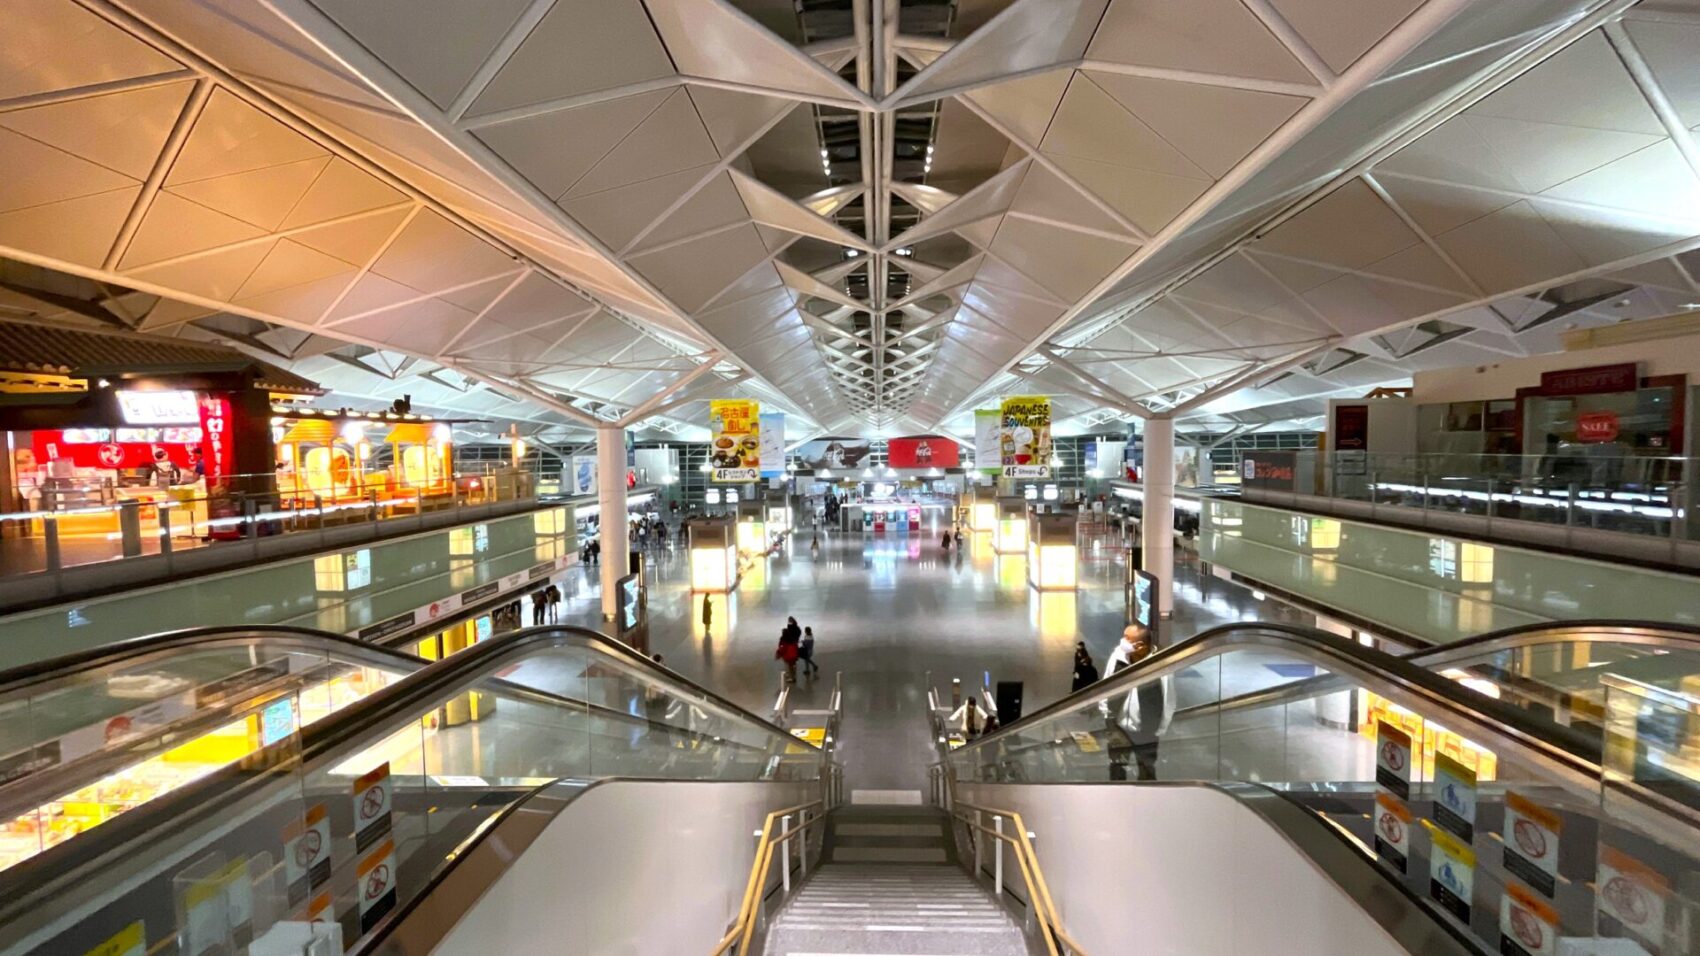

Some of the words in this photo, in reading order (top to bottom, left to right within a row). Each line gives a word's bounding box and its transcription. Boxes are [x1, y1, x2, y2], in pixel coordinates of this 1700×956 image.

[720, 407, 750, 419] 名古屋
[1004, 404, 1050, 416] JAPANESE
[1002, 415, 1050, 427] SOUVENIRS
[1581, 422, 1611, 432] SALE
[716, 469, 728, 479] 4F
[1005, 467, 1017, 477] 4F
